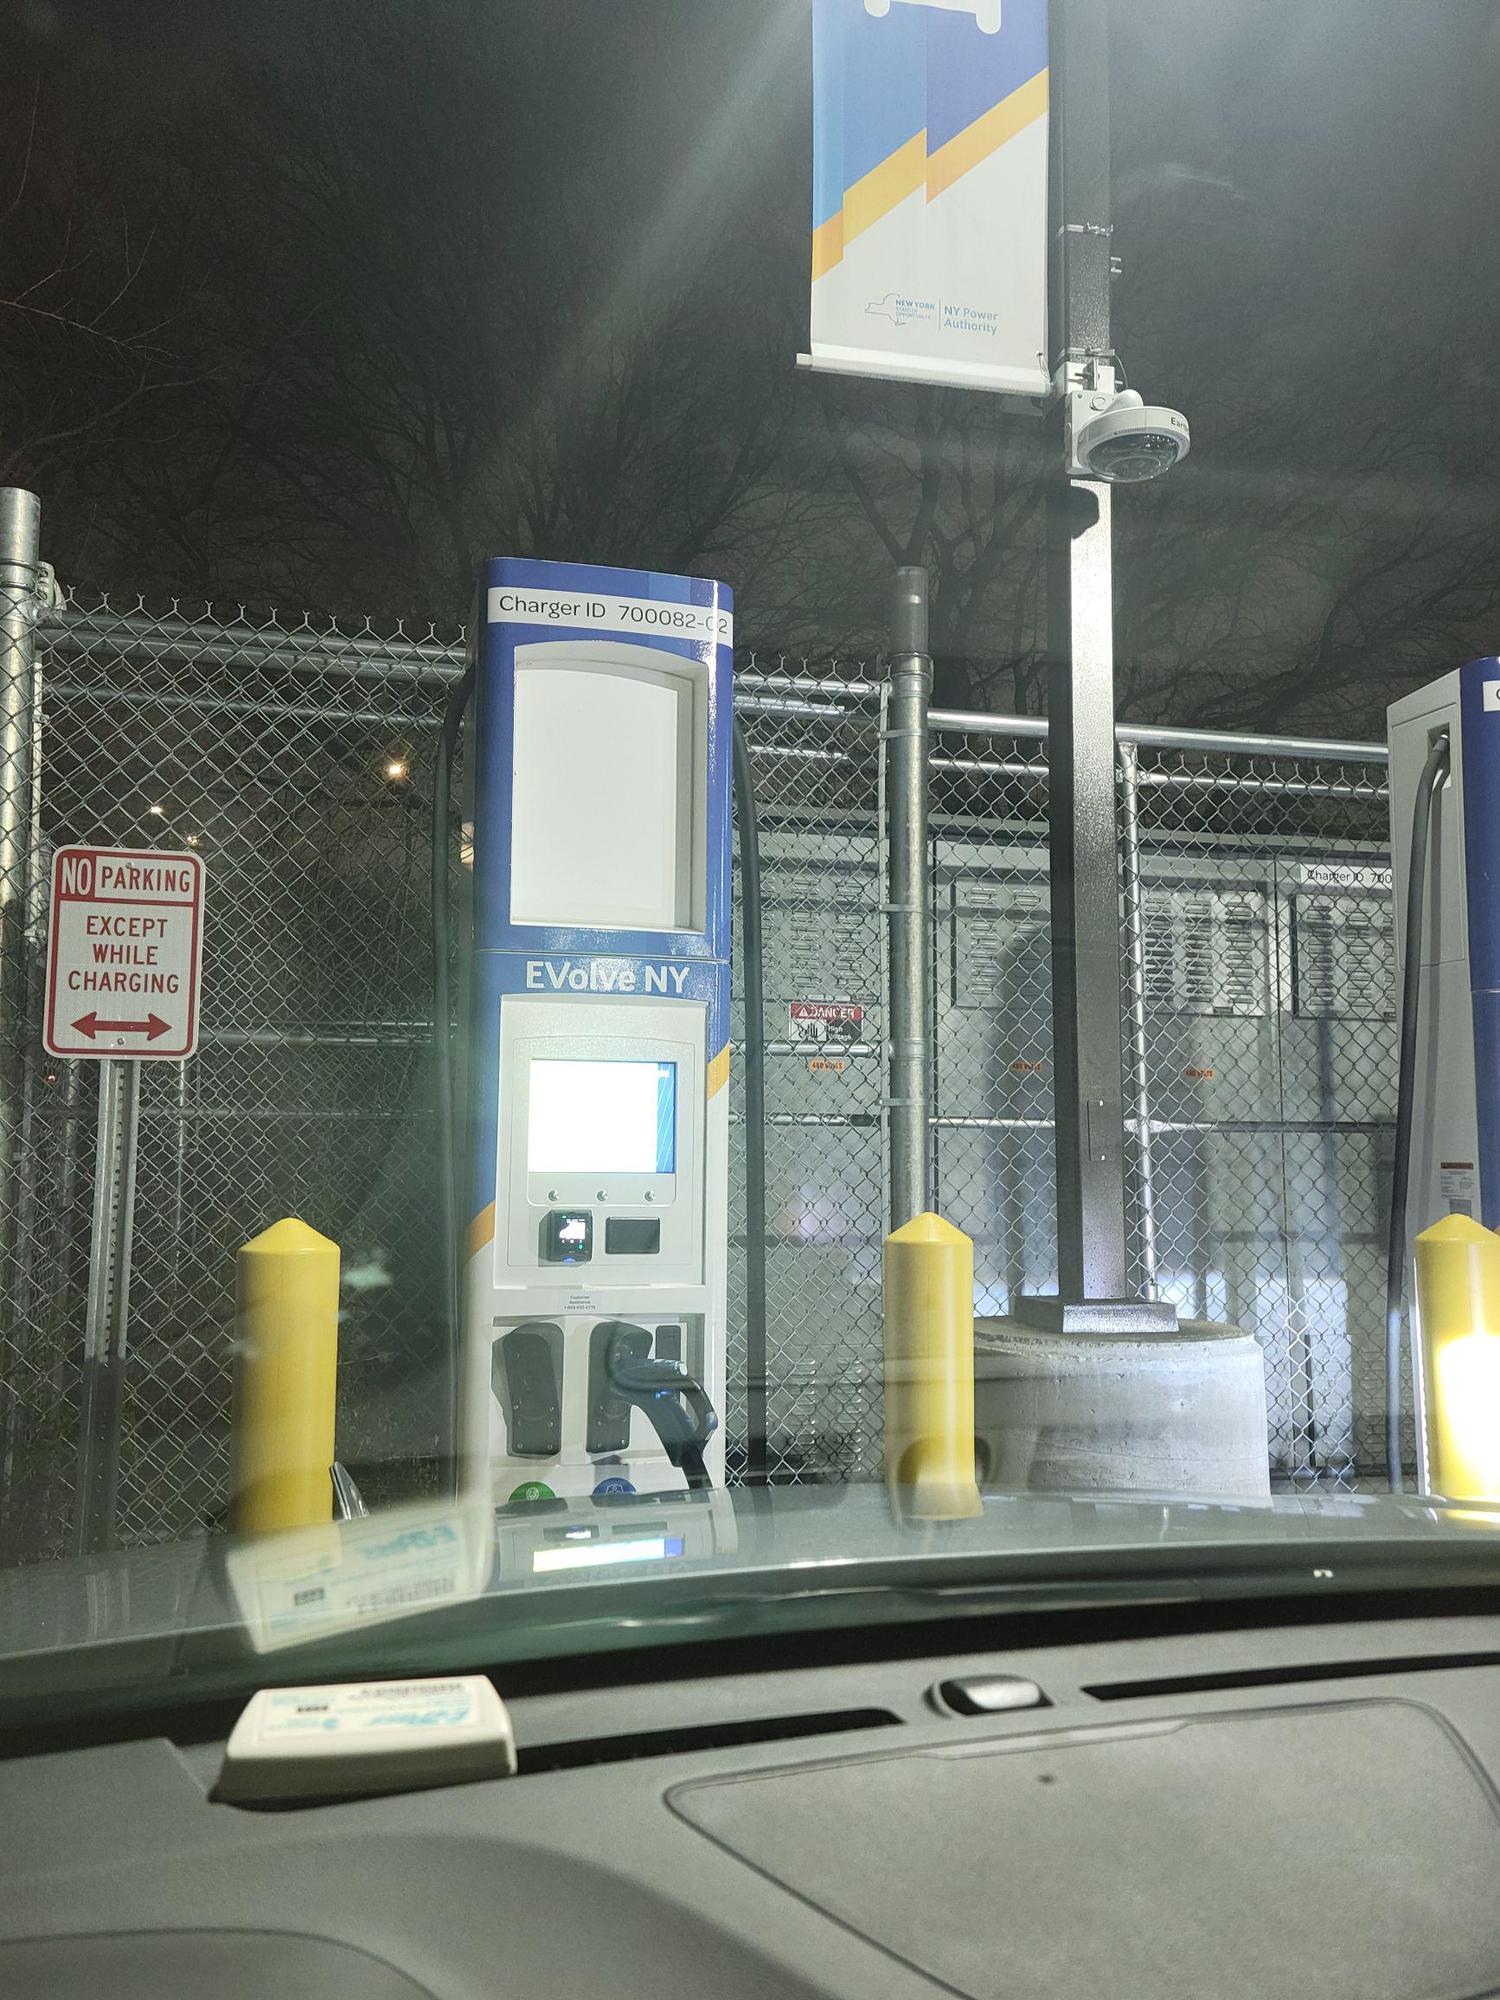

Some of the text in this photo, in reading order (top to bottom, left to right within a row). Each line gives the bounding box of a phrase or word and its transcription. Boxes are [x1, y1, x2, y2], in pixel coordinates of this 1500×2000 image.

[895, 299, 936, 311] NEW YORK
[944, 305, 998, 321] NY Power
[944, 317, 998, 336] Authority
[499, 594, 581, 619] Charger
[586, 602, 606, 619] ID
[61, 856, 190, 896] NO PARKING
[1307, 868, 1350, 884] Charger
[86, 915, 168, 938] EXCEPT
[92, 943, 158, 966] WHILE
[68, 970, 179, 994] CHARGING
[526, 960, 690, 993] EVolve NY
[811, 1005, 855, 1019] DANGER
